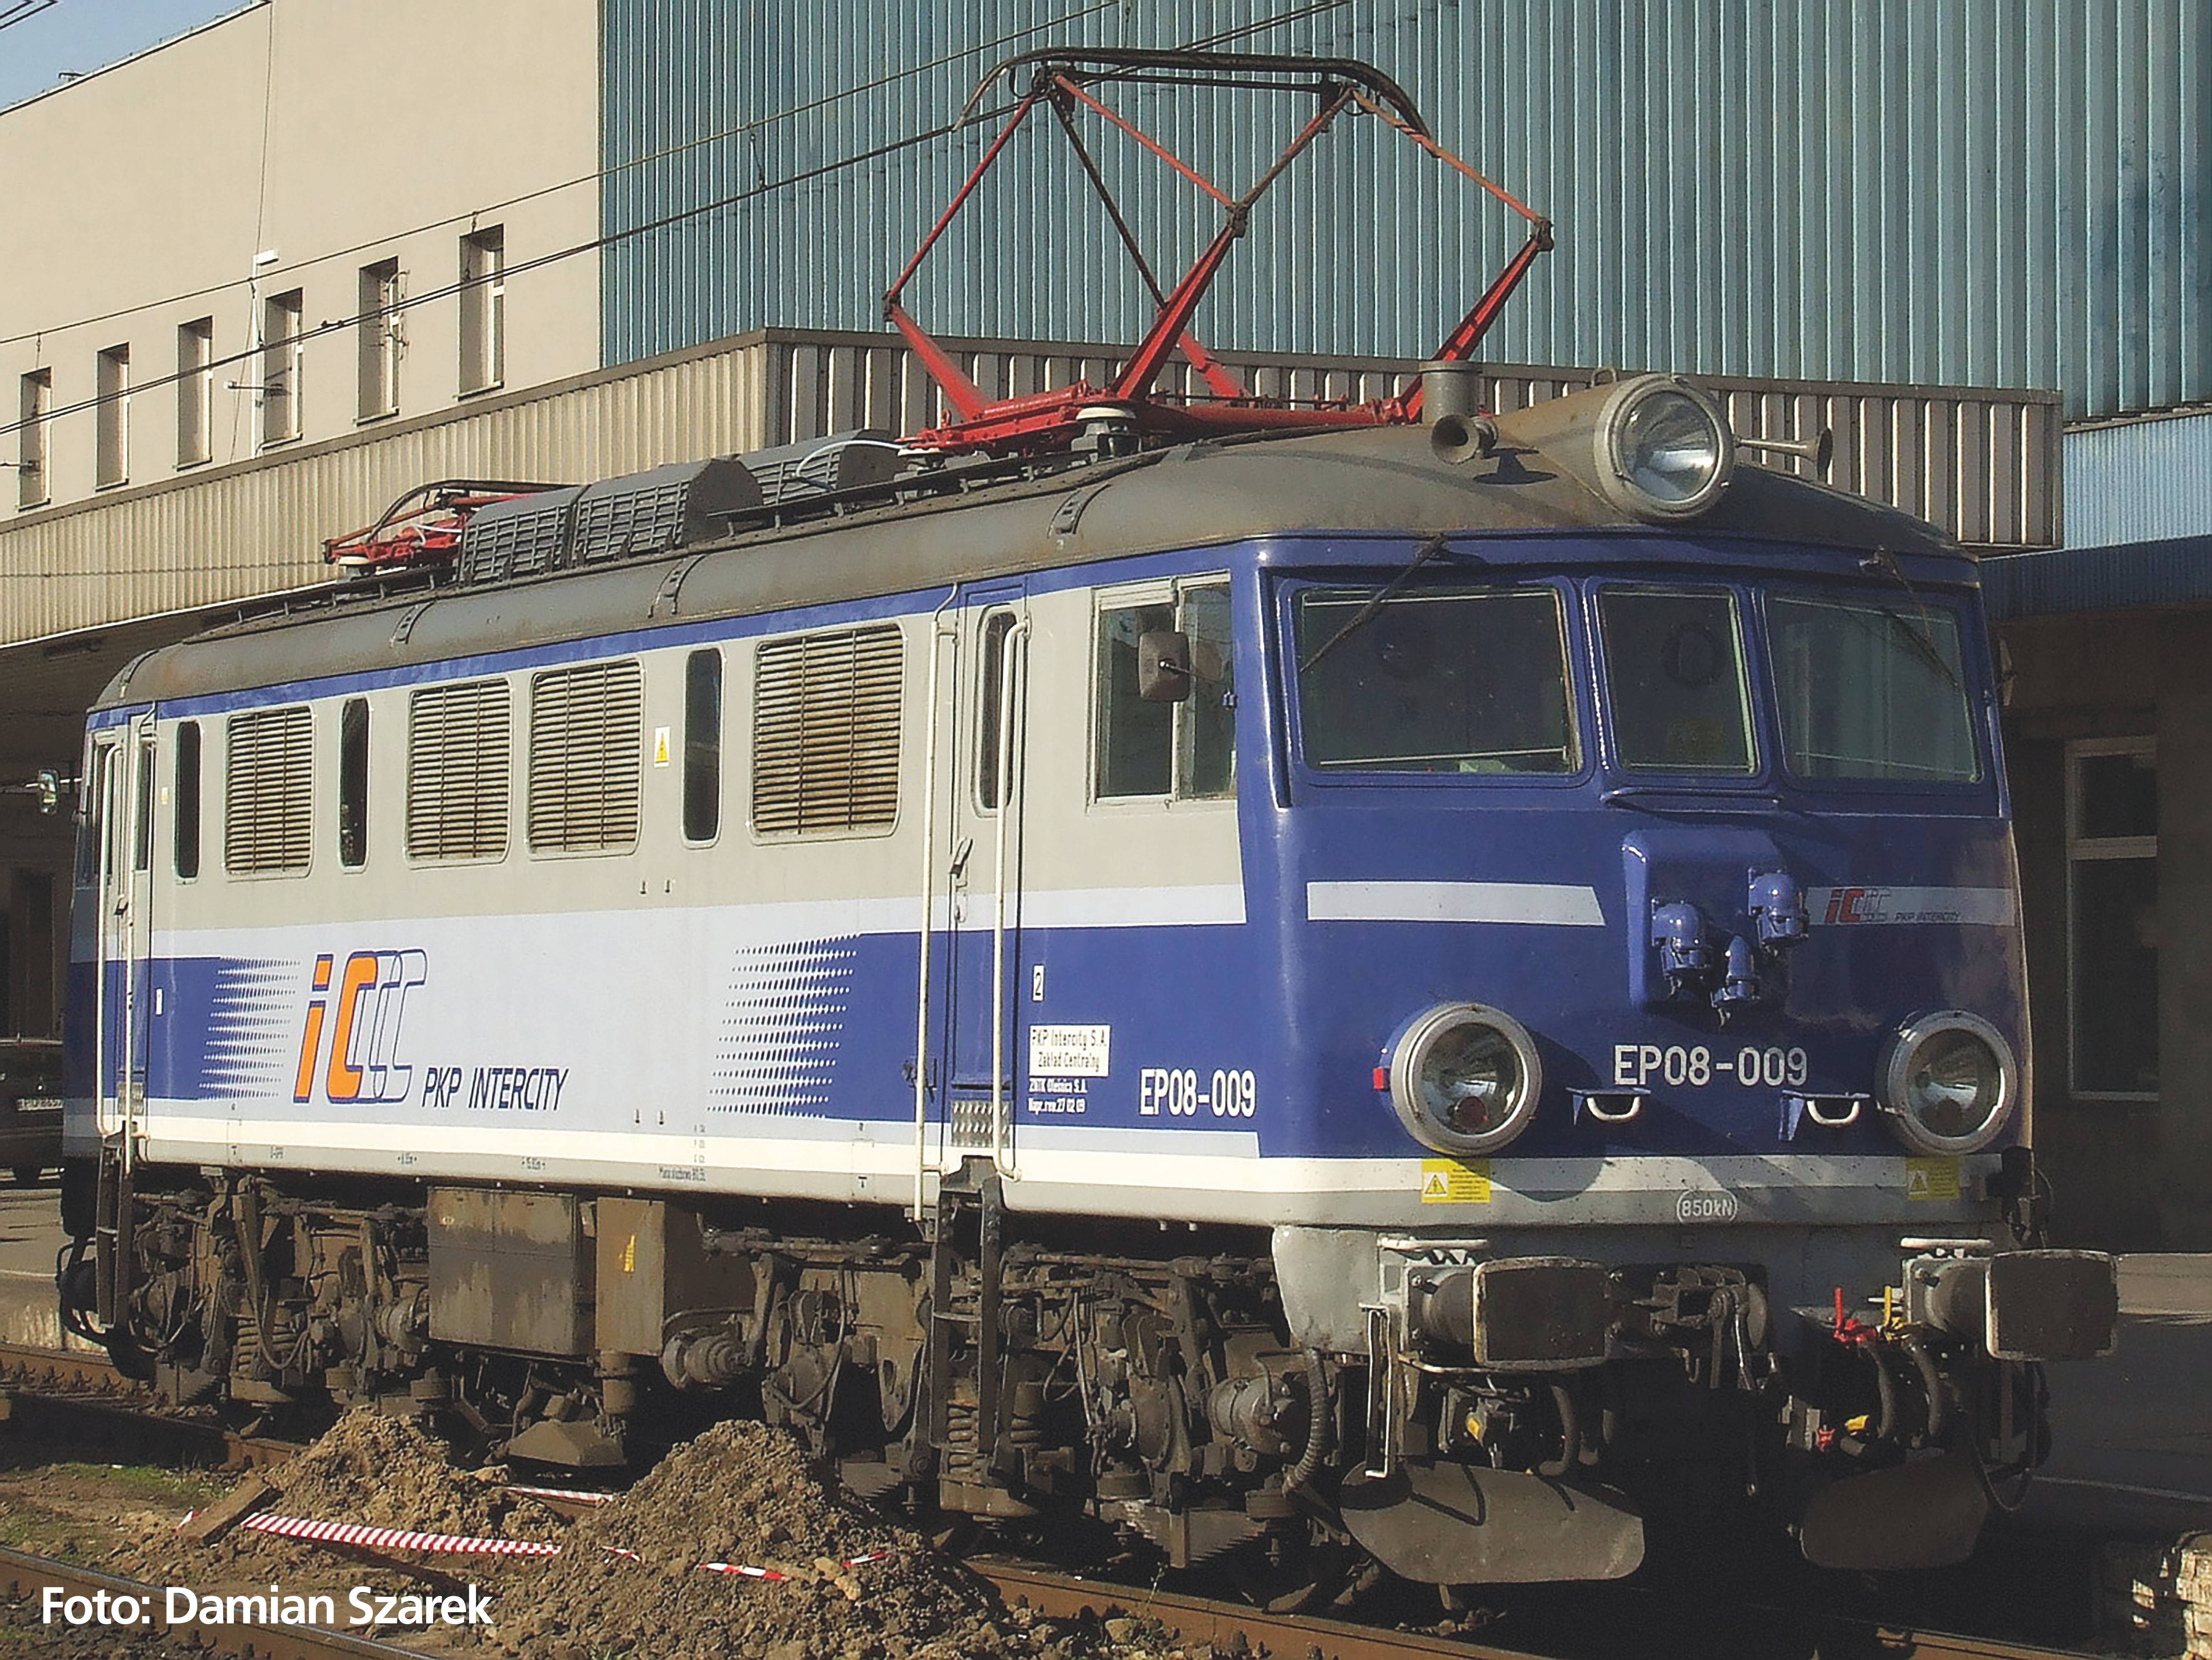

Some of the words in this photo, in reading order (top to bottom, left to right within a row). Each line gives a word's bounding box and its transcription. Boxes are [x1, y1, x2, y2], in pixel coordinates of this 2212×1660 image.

[1035, 971, 1042, 996] 2
[1051, 1029, 1087, 1051] Intercity
[1614, 1044, 1808, 1087] EP08-009
[421, 1067, 462, 1109] PKP
[468, 1068, 569, 1111] INTERCITY
[1140, 1068, 1256, 1117] EP08-009
[1681, 1199, 1733, 1216] 850kN
